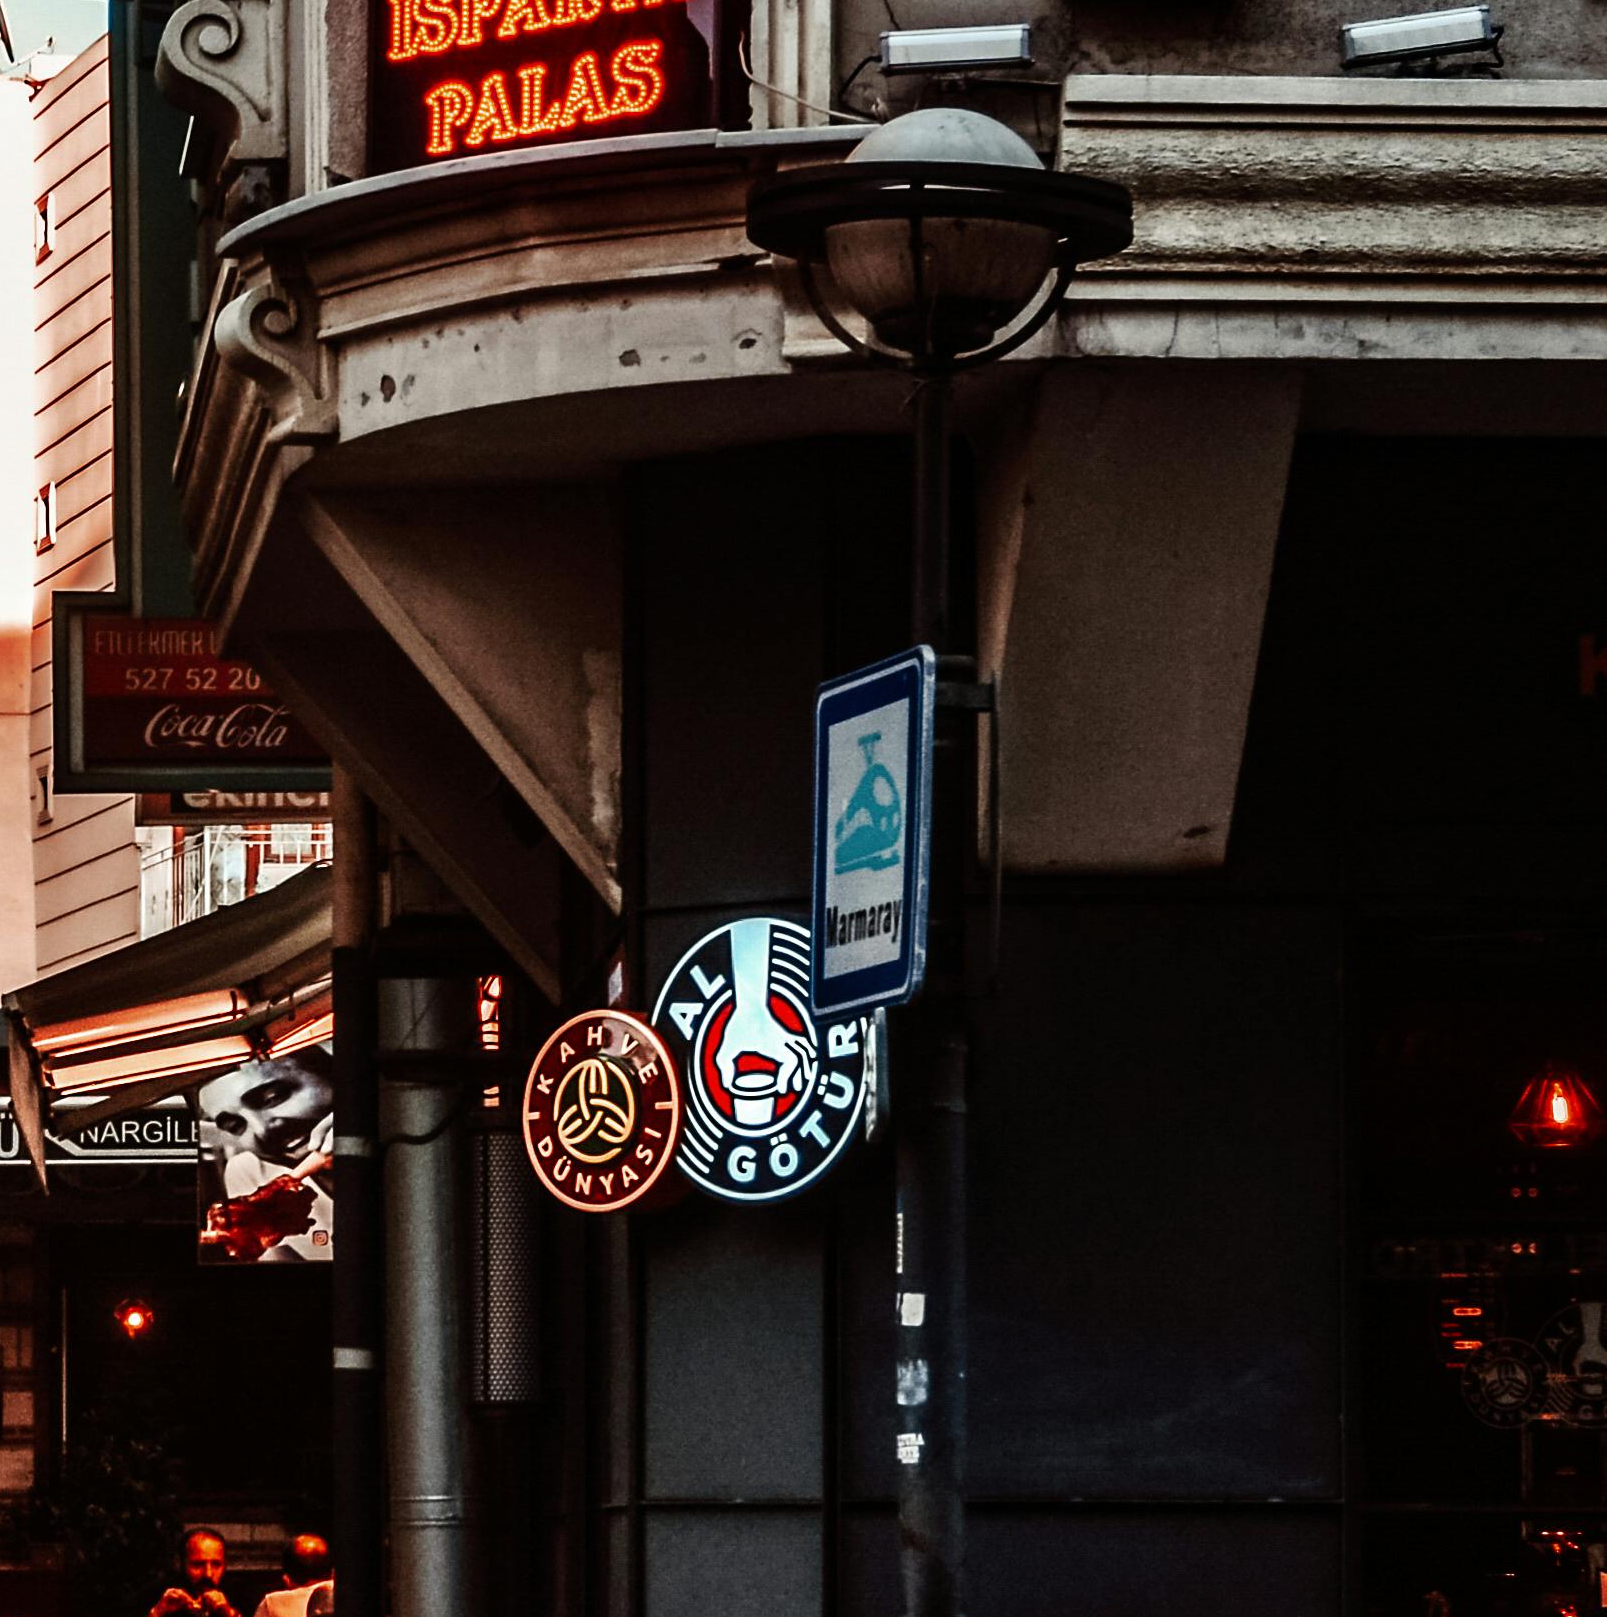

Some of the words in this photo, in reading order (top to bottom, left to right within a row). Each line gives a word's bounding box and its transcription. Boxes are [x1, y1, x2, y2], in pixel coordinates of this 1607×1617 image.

[424, 40, 663, 157] PALAS
[125, 668, 173, 690] 527
[186, 668, 217, 690] 52
[825, 899, 902, 949] Marmaray
[669, 965, 726, 1041] AL
[537, 1026, 658, 1096] KAHVE
[537, 1127, 661, 1196] DÜNYASI
